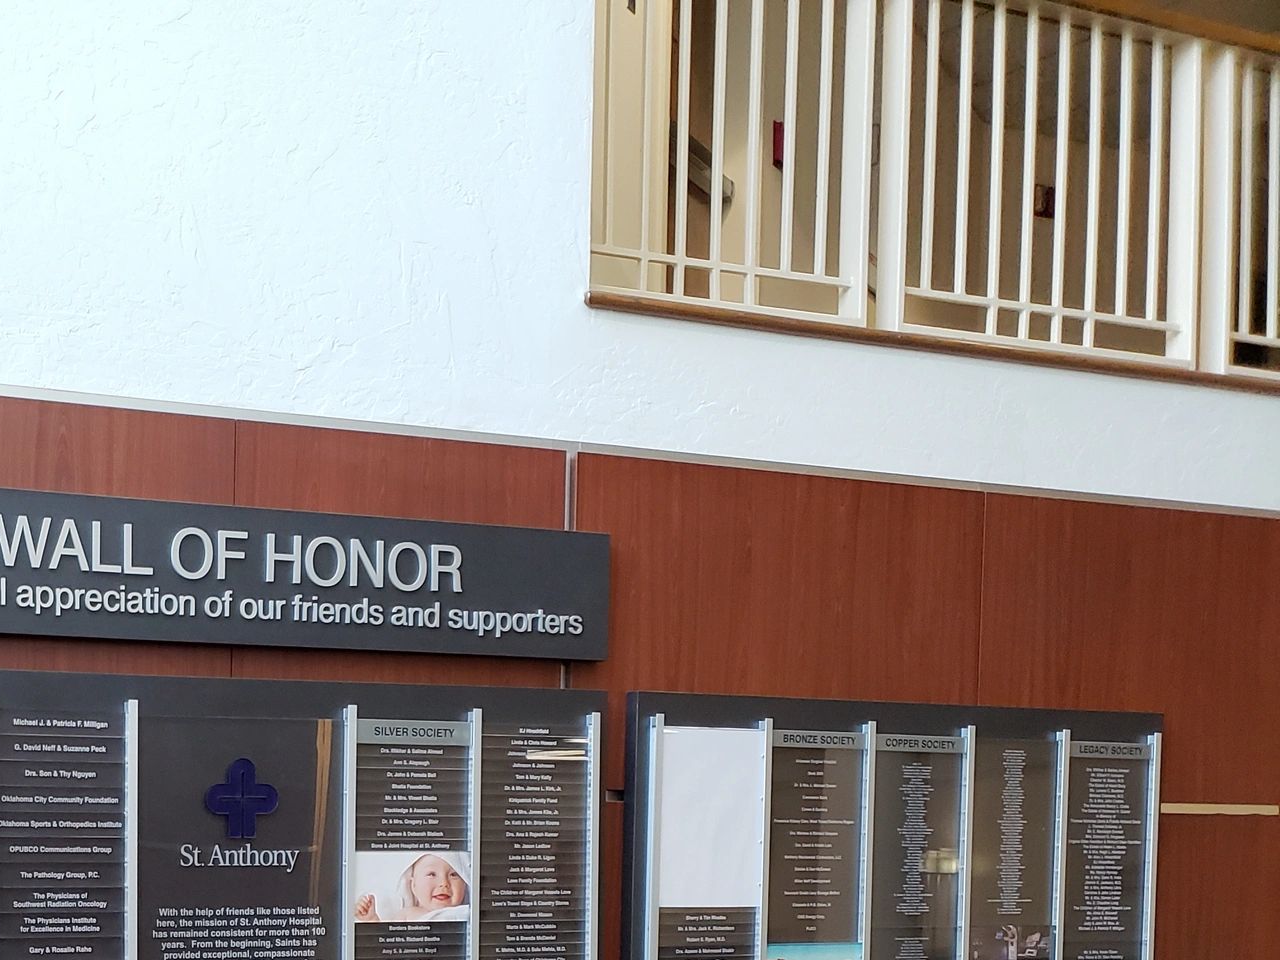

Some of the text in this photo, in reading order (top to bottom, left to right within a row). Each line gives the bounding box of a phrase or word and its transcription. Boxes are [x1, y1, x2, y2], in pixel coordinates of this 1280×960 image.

[170, 527, 248, 579] OF
[265, 534, 462, 591] HONOR
[15, 585, 195, 615] appreciation
[203, 590, 232, 617] of
[239, 598, 286, 619] our
[291, 594, 383, 624] friends
[390, 602, 440, 627] and
[447, 609, 582, 636] supporters
[374, 726, 454, 738] SILVER SOCIETY
[782, 734, 856, 745] BRONZE SOCIETY
[885, 738, 955, 749] COPPER SOCIETY
[1079, 745, 1142, 755] LEGACY SOCIETY
[180, 843, 299, 872] St. Anthony
[158, 906, 319, 917] With the help of friends like those listed
[163, 948, 315, 960] provided exceptional, compassionate
